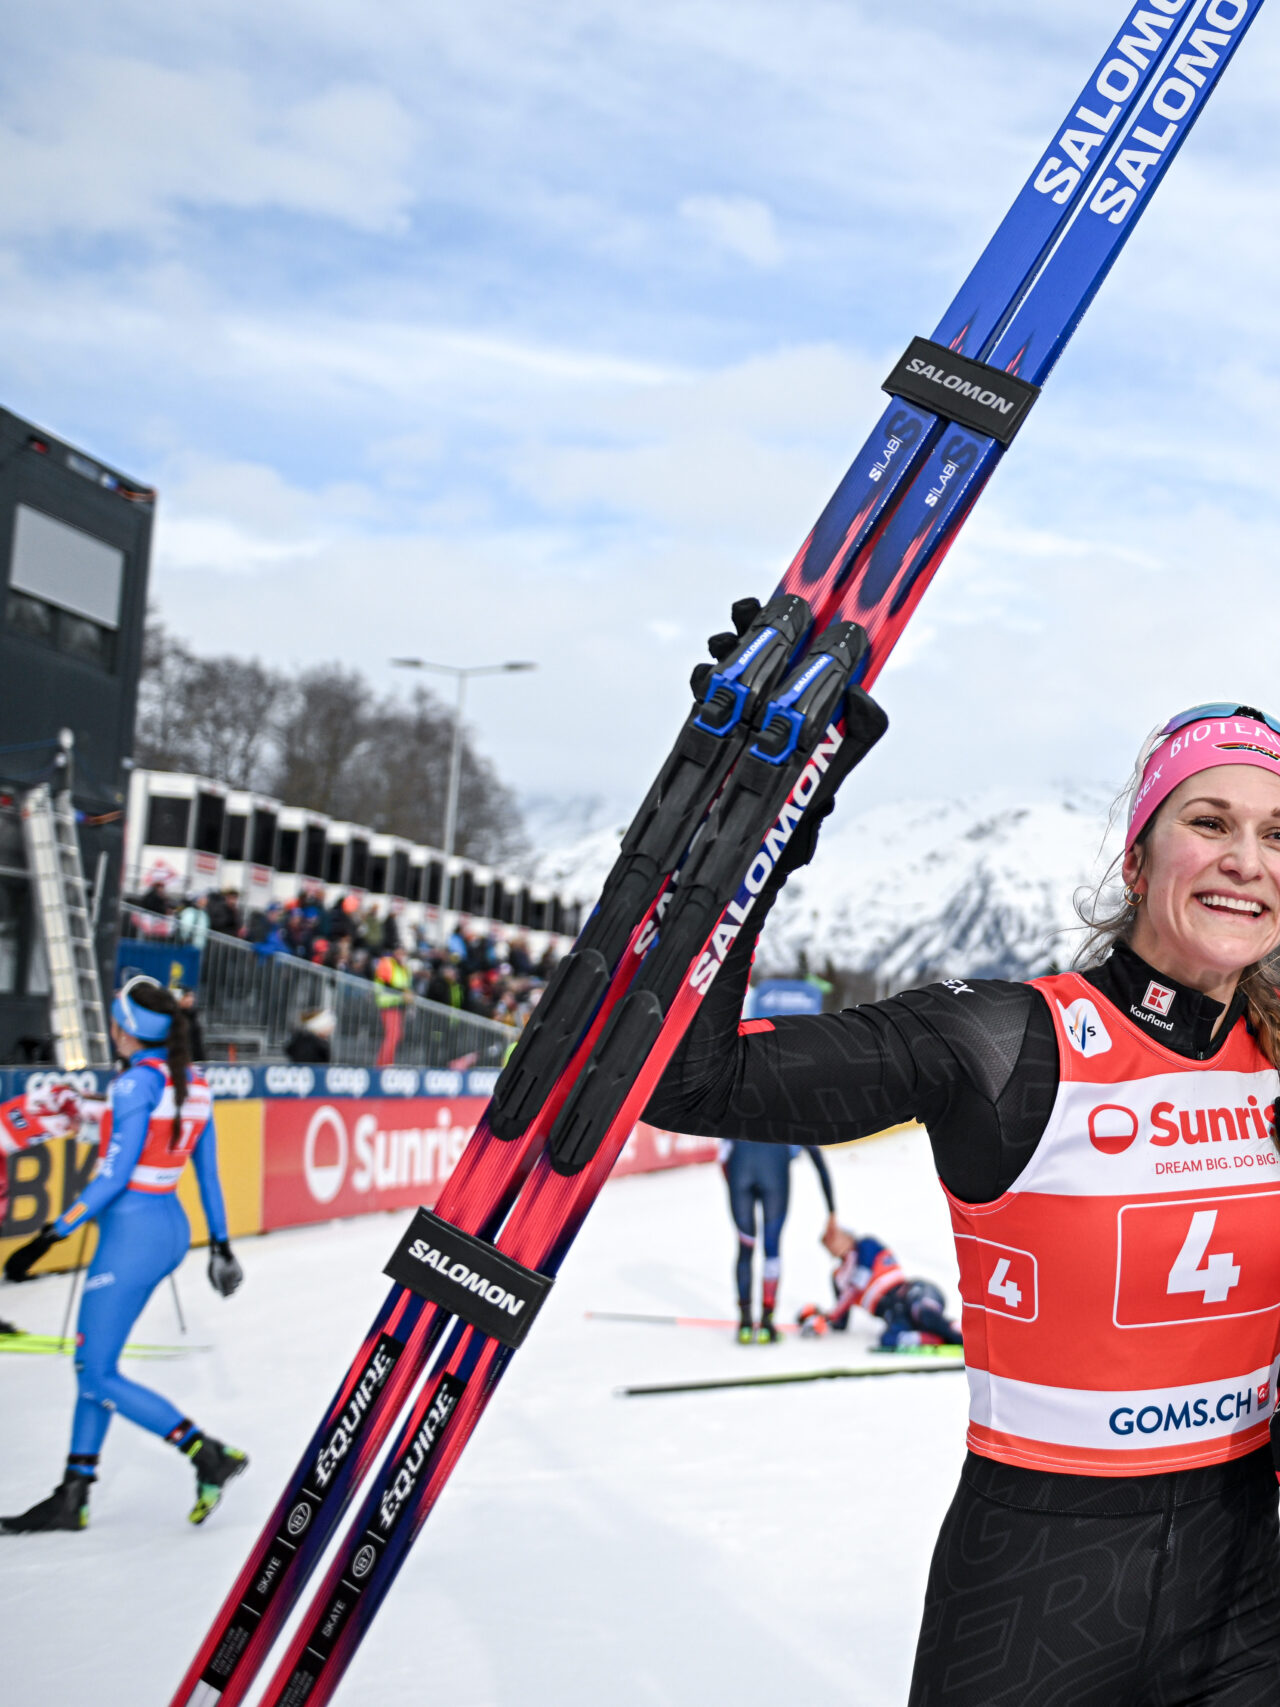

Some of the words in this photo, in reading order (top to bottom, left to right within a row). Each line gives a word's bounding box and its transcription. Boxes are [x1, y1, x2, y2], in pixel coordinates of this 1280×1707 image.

[905, 358, 1014, 415] SALOMON
[738, 629, 772, 666] SALOMON
[793, 656, 829, 693] SALOMON
[689, 722, 844, 995] SALOMON
[1130, 1004, 1174, 1031] Kaufland
[1155, 1159, 1203, 1175] DREAM
[1206, 1157, 1232, 1171] BIG.
[1233, 1154, 1254, 1168] DO
[1256, 1153, 1279, 1166] BIG.
[1166, 1209, 1241, 1305] 4
[408, 1239, 526, 1316] SALOMON
[987, 1258, 1022, 1309] 4
[1109, 1387, 1253, 1436] GOMS.CH
[290, 1505, 309, 1530] 187
[257, 1557, 281, 1594] SKATE
[355, 1547, 372, 1573] 187
[321, 1600, 346, 1637] SKATE
